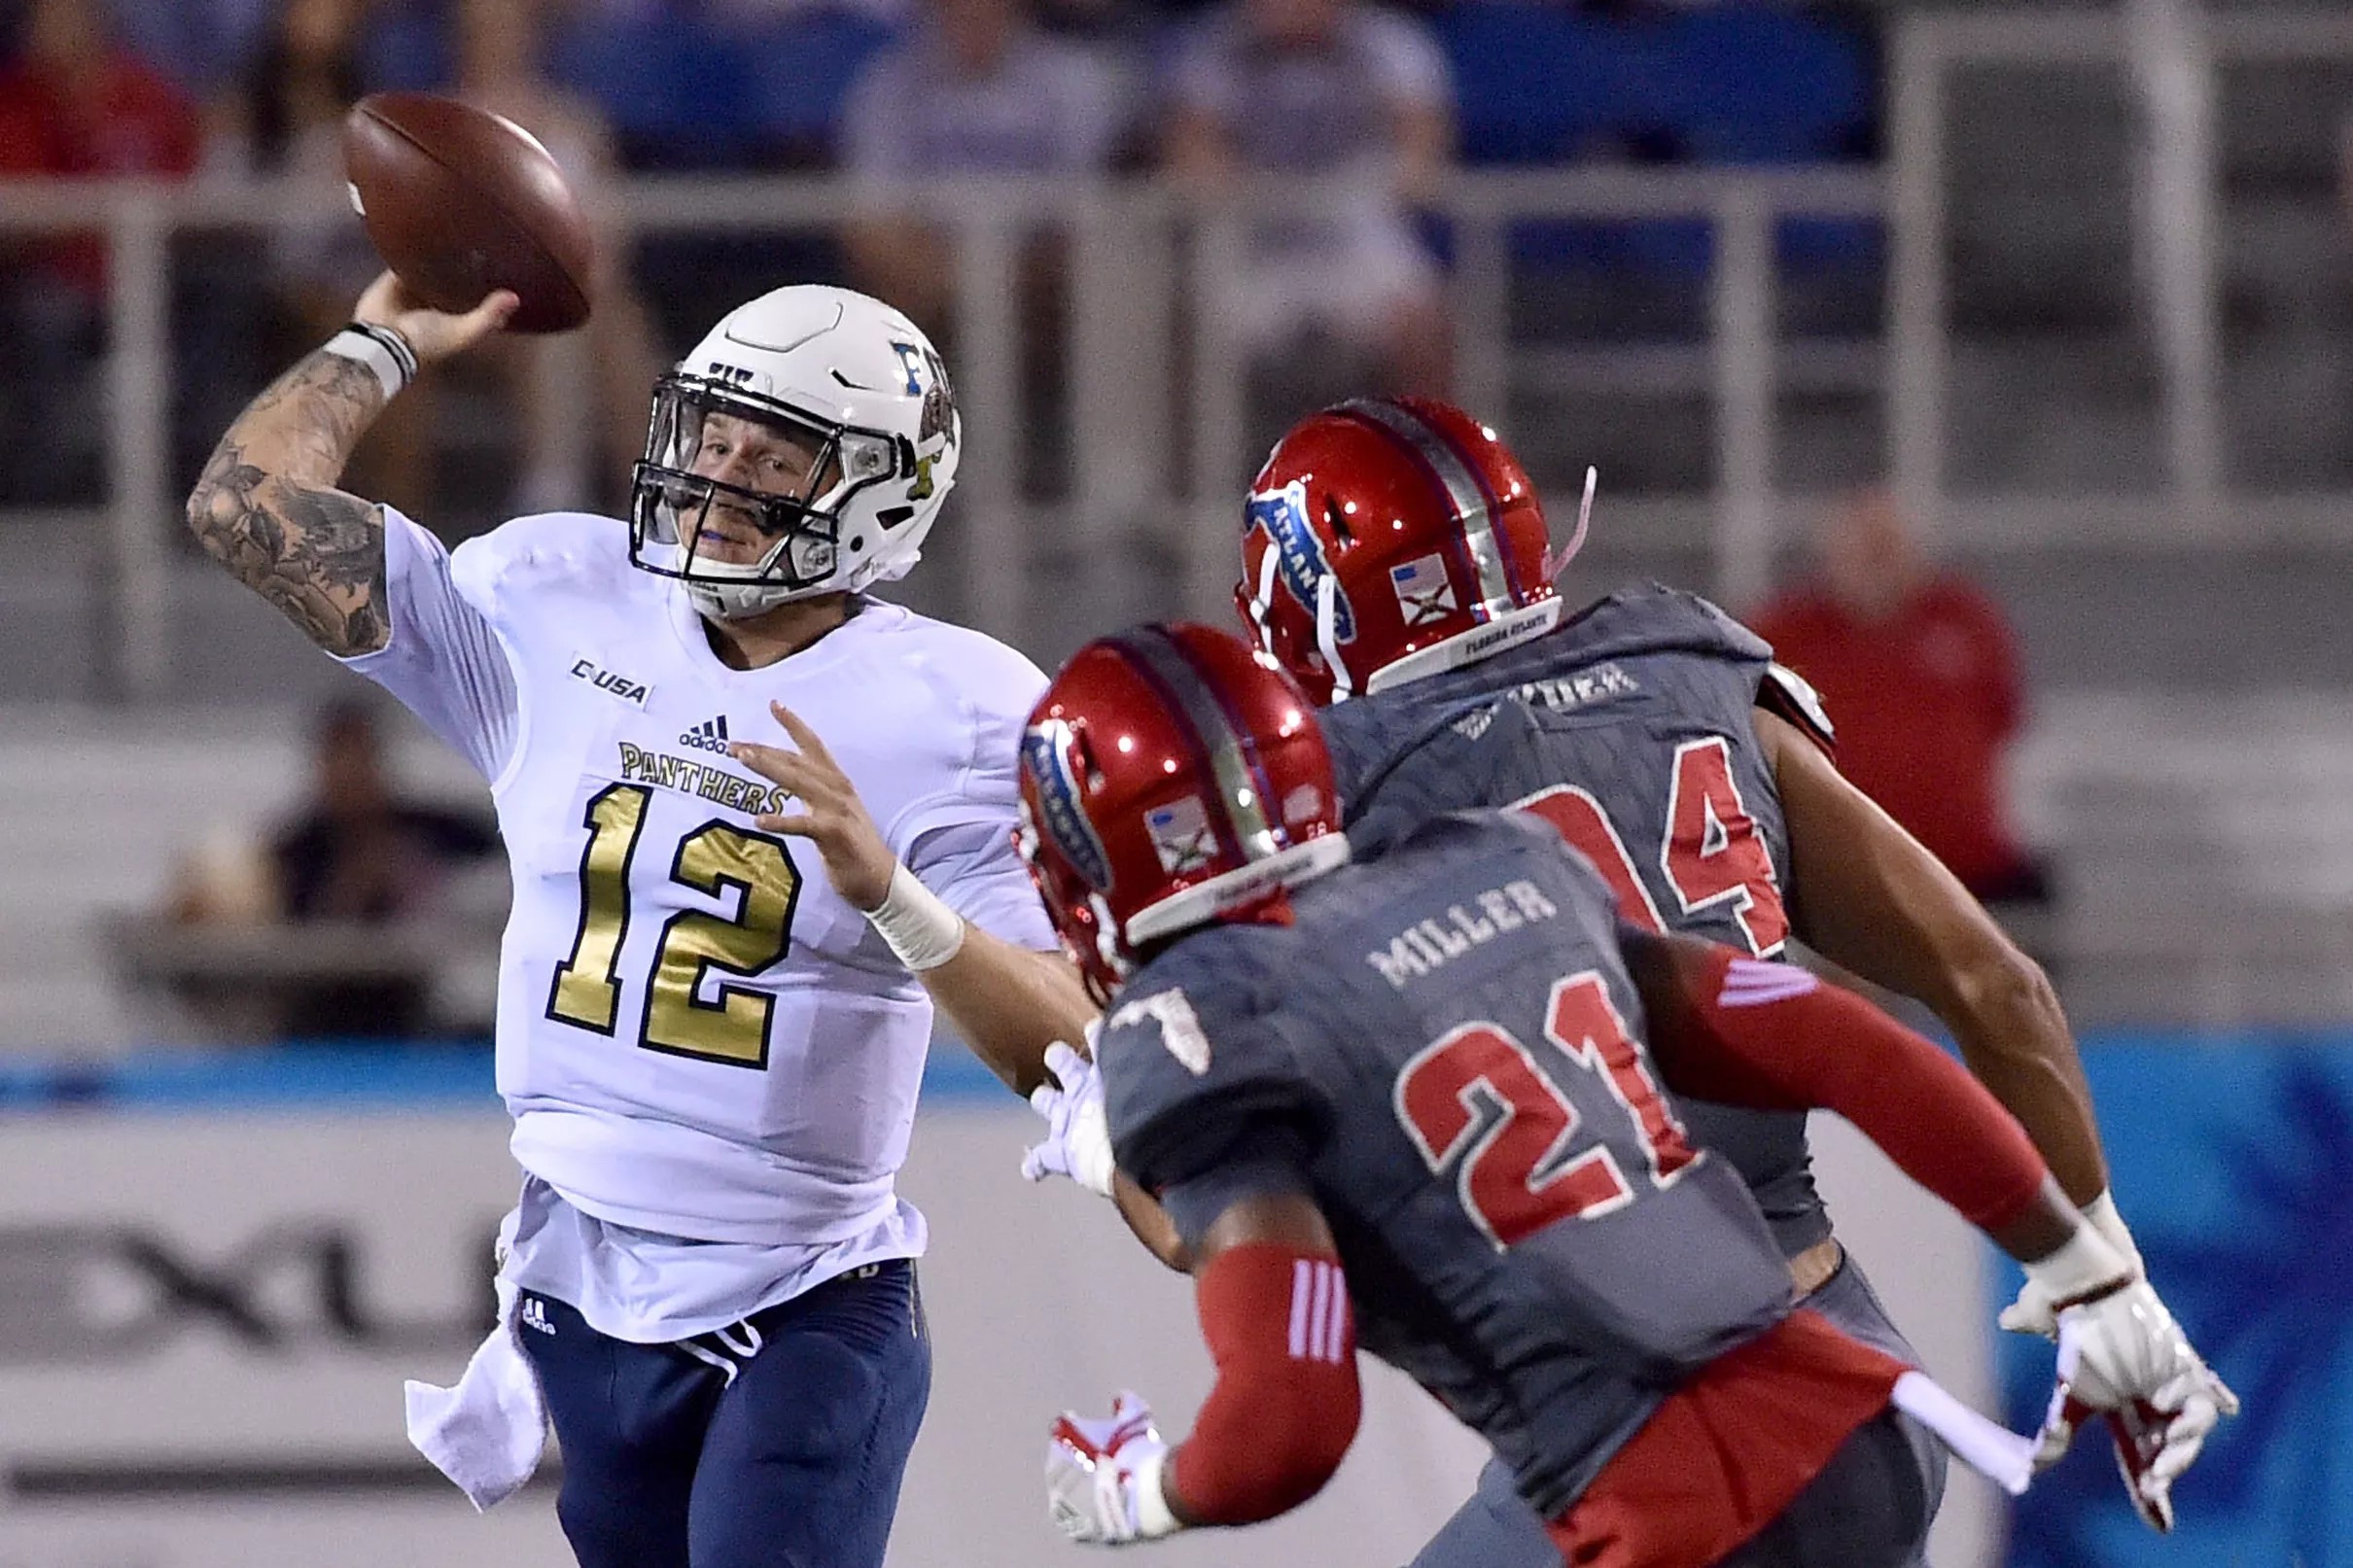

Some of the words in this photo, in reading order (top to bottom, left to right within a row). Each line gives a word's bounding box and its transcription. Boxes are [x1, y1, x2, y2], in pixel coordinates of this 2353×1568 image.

[618, 741, 792, 819] PANTHERS
[544, 781, 803, 1071] 12
[1364, 879, 1558, 993] MILLER
[1394, 969, 1707, 1255] 21
